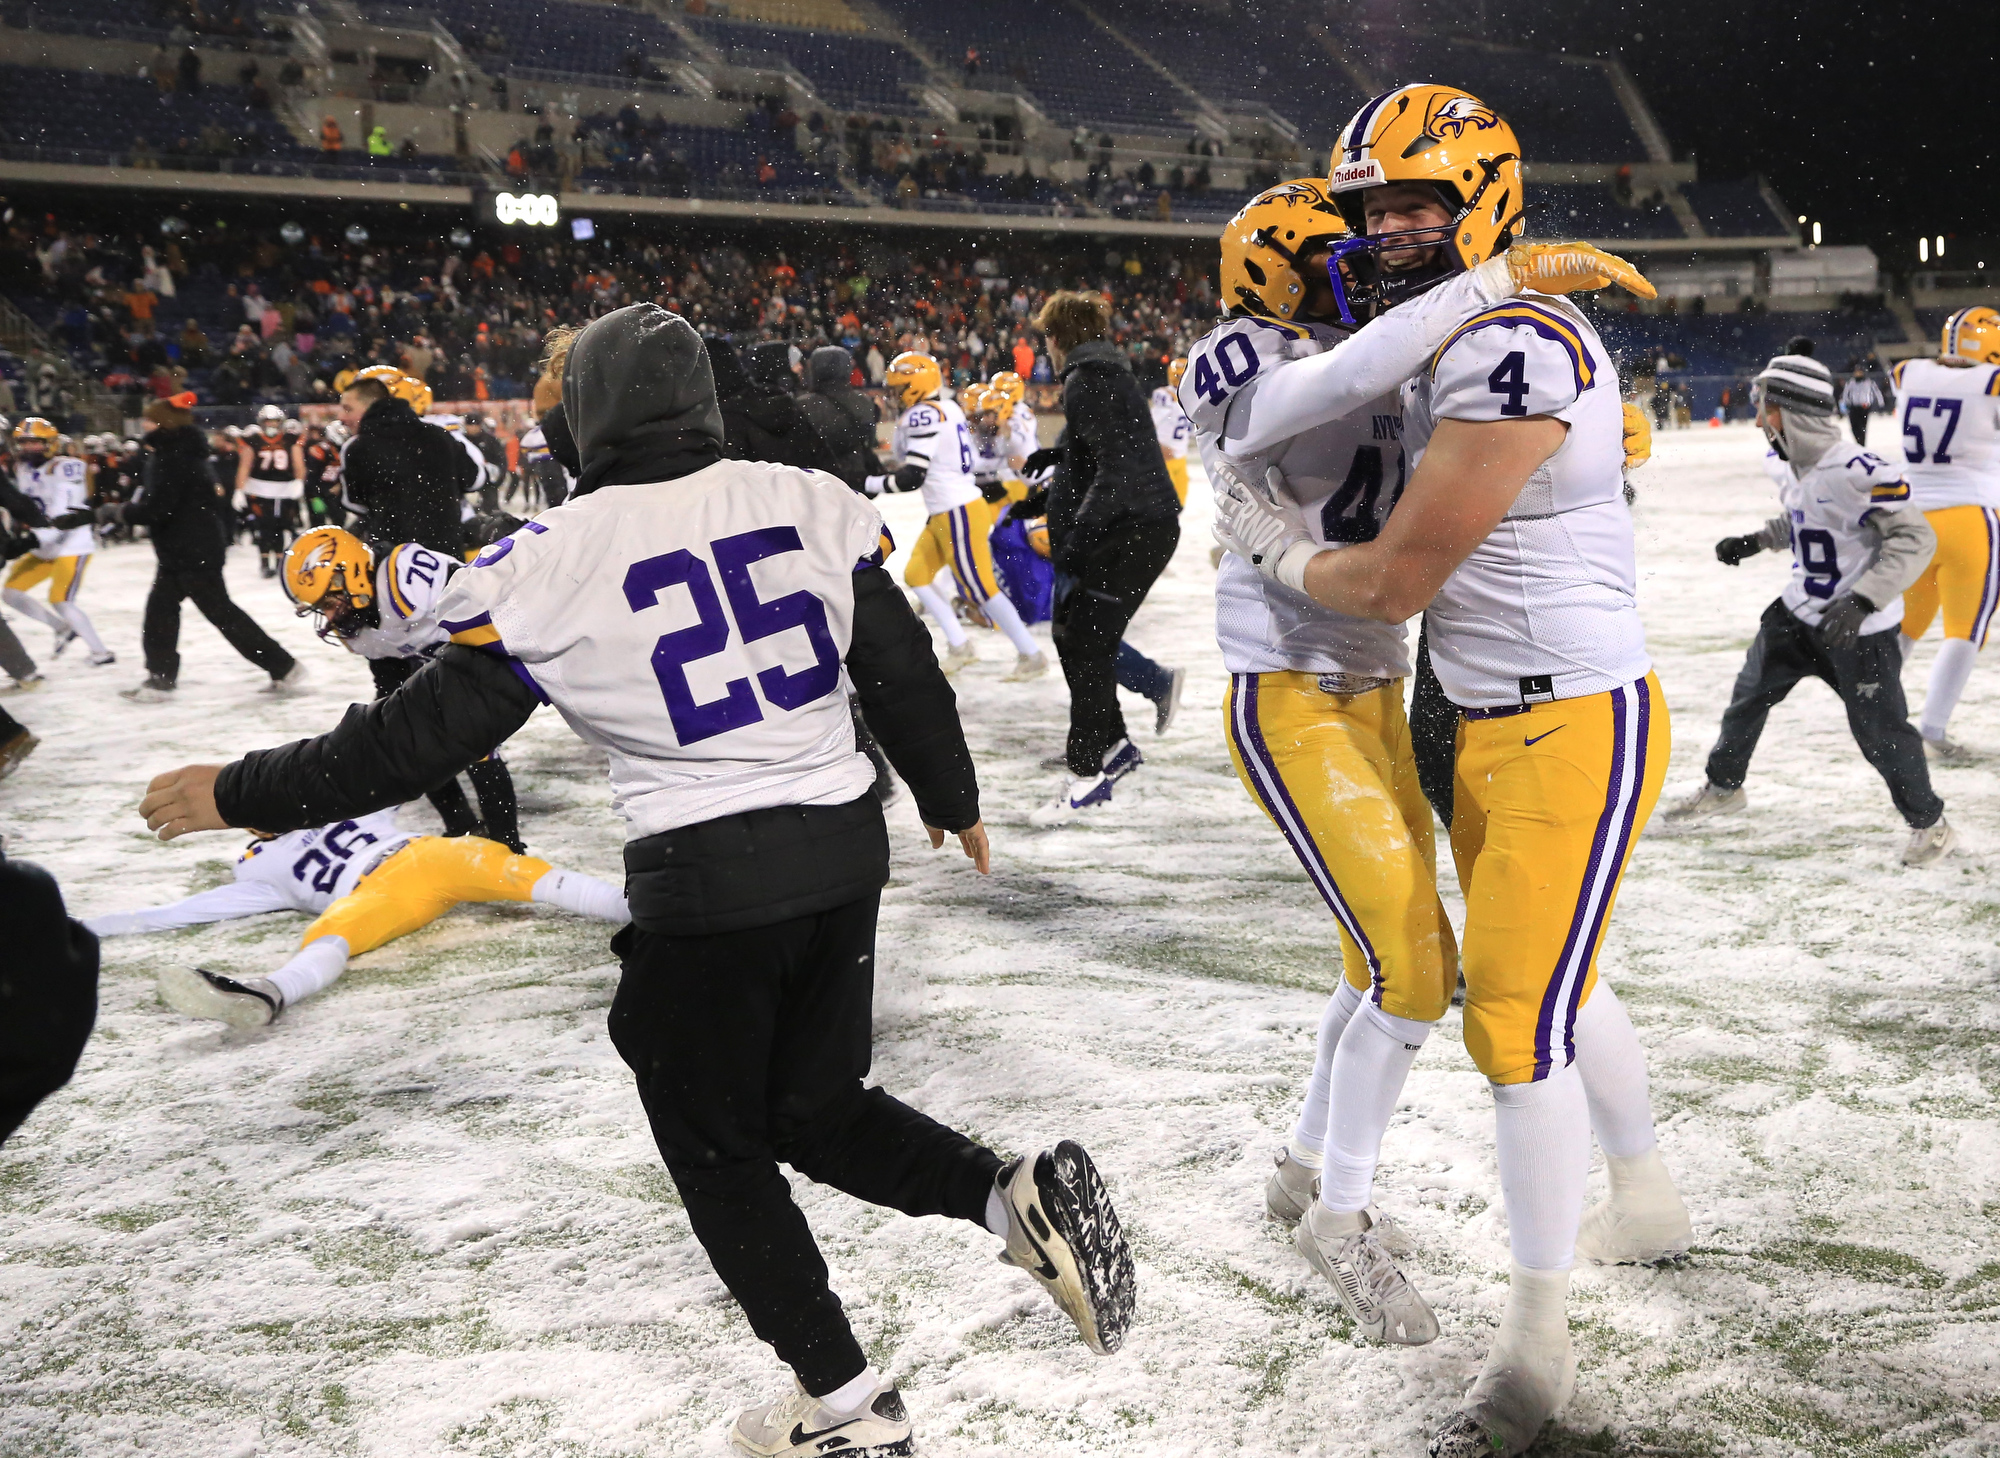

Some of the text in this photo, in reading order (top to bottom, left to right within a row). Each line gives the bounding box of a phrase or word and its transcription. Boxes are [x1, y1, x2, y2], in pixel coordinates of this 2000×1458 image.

[1334, 165, 1375, 184] Riddell
[496, 192, 558, 227] 0:00
[1194, 331, 1261, 407] 40
[1487, 351, 1530, 416] 4
[909, 410, 931, 428] 65
[1903, 396, 1963, 464] 57
[258, 449, 289, 471] 79
[957, 423, 973, 474] 6
[406, 550, 440, 588] 70
[1790, 527, 1843, 600] 9
[622, 525, 840, 748] 25
[1532, 680, 1540, 690] L
[292, 819, 378, 894] 26
